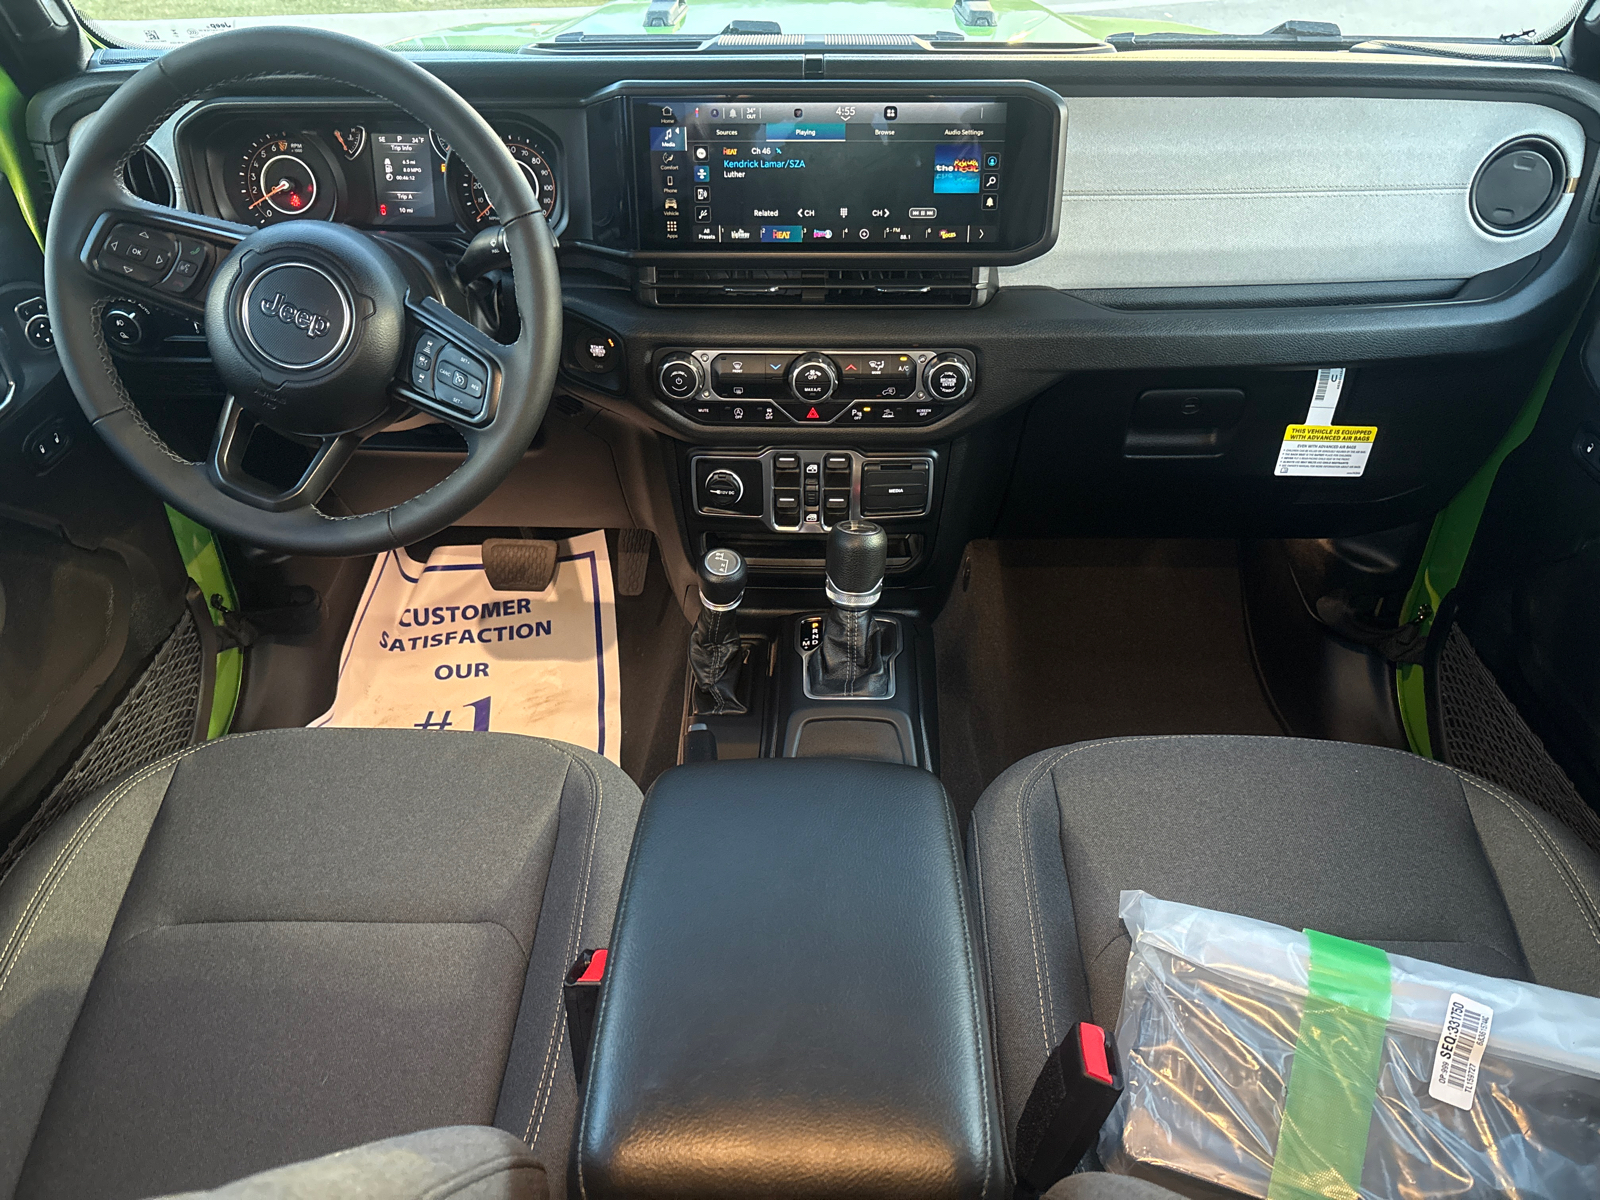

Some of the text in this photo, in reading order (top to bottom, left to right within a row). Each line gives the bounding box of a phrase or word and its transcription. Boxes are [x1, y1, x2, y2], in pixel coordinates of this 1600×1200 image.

[836, 107, 856, 116] 4:55
[795, 129, 816, 137] Playing
[961, 129, 984, 137] Settings
[397, 135, 402, 143] P
[751, 147, 761, 155] Ch
[723, 160, 806, 169] Kendrick Lamar/SZA
[753, 209, 779, 217] Related
[871, 209, 883, 217] CH
[131, 248, 142, 256] OK
[260, 292, 331, 338] Jeep
[398, 598, 531, 628] CUSTOMER
[379, 620, 552, 652] SATISFACTION
[434, 662, 490, 681] OUR
[1440, 1001, 1464, 1060] SEQ:331750
